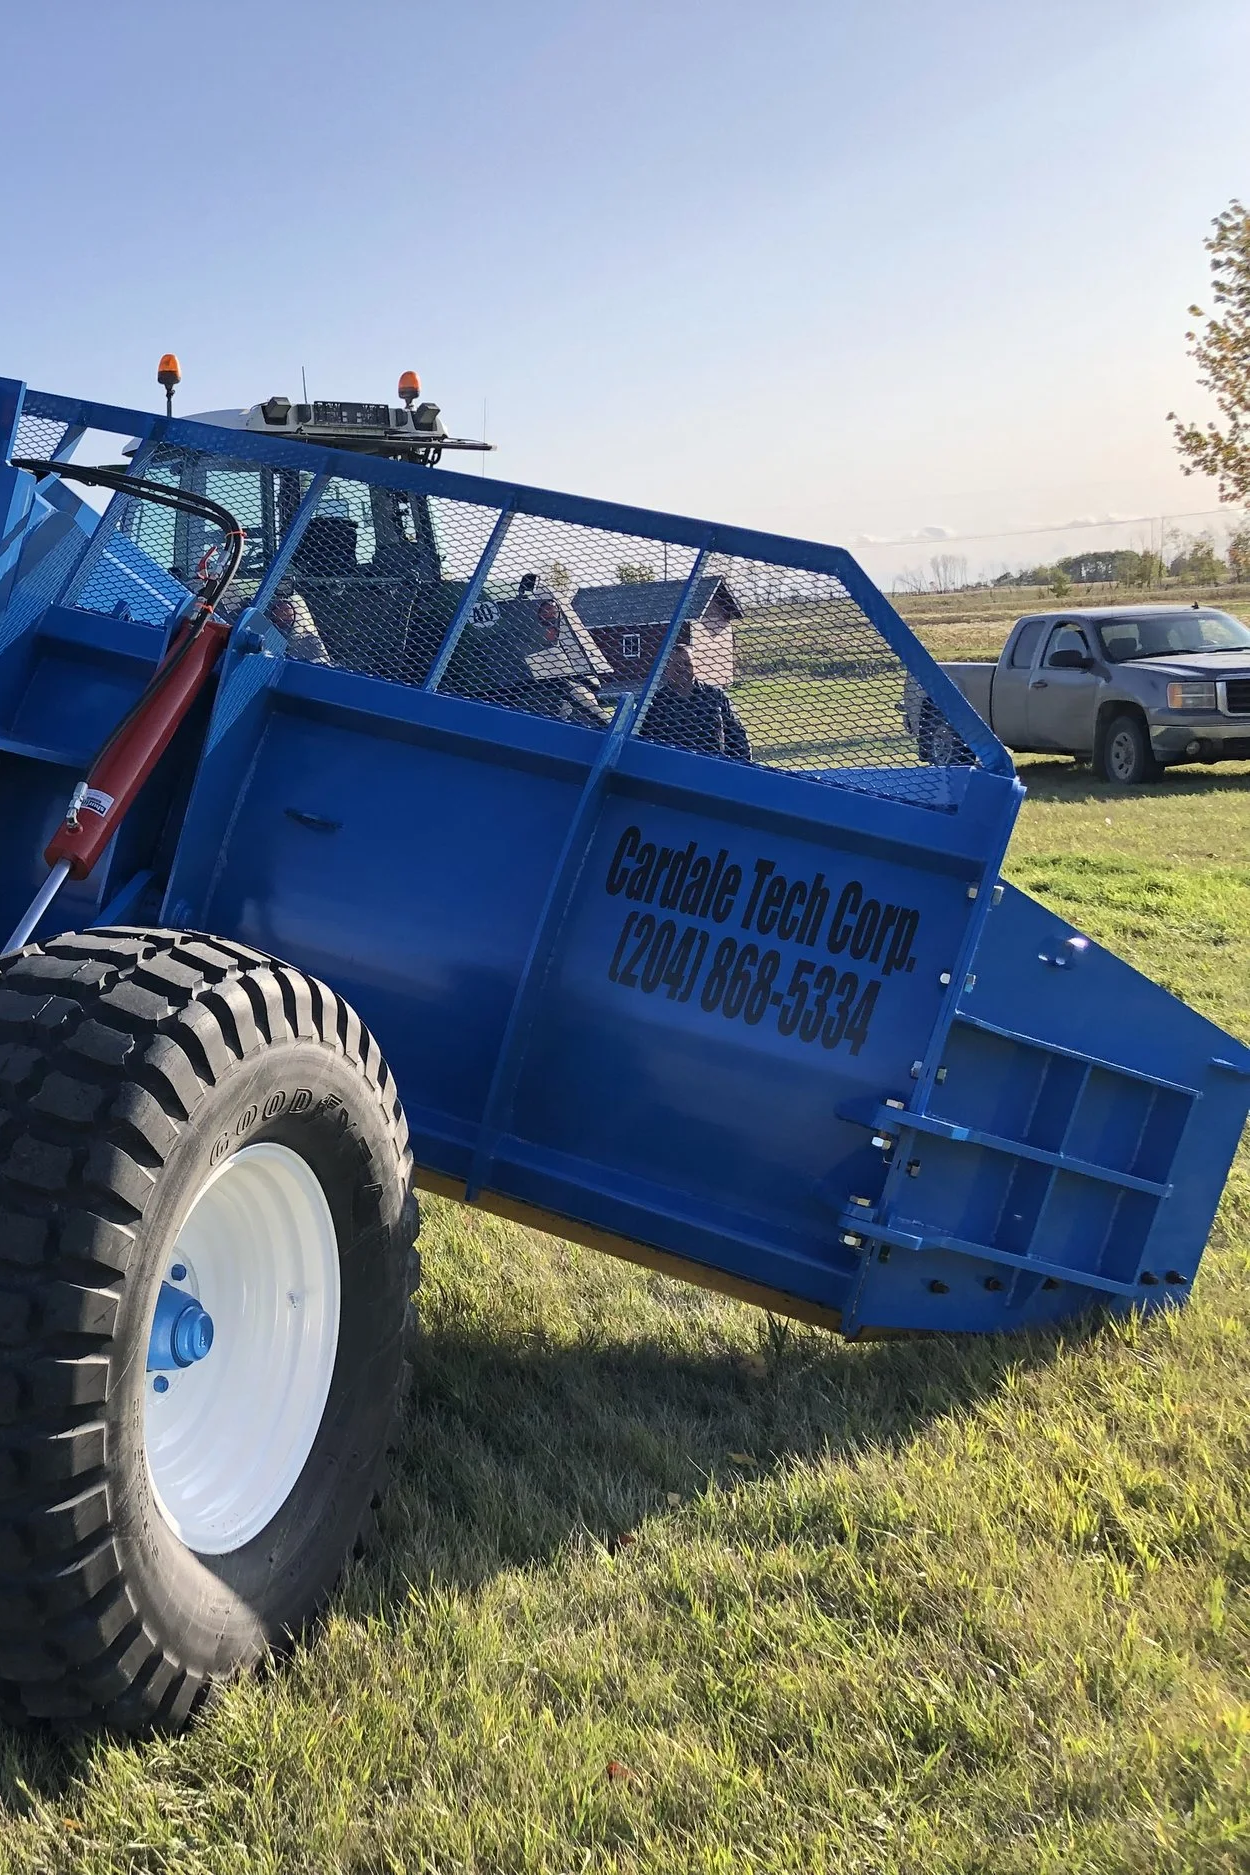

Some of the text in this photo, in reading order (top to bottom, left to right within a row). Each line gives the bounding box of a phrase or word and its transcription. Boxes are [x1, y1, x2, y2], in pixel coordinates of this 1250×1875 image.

[605, 825, 921, 976] Cardale Tech Corp.
[608, 910, 882, 1056] (204) 868-5334
